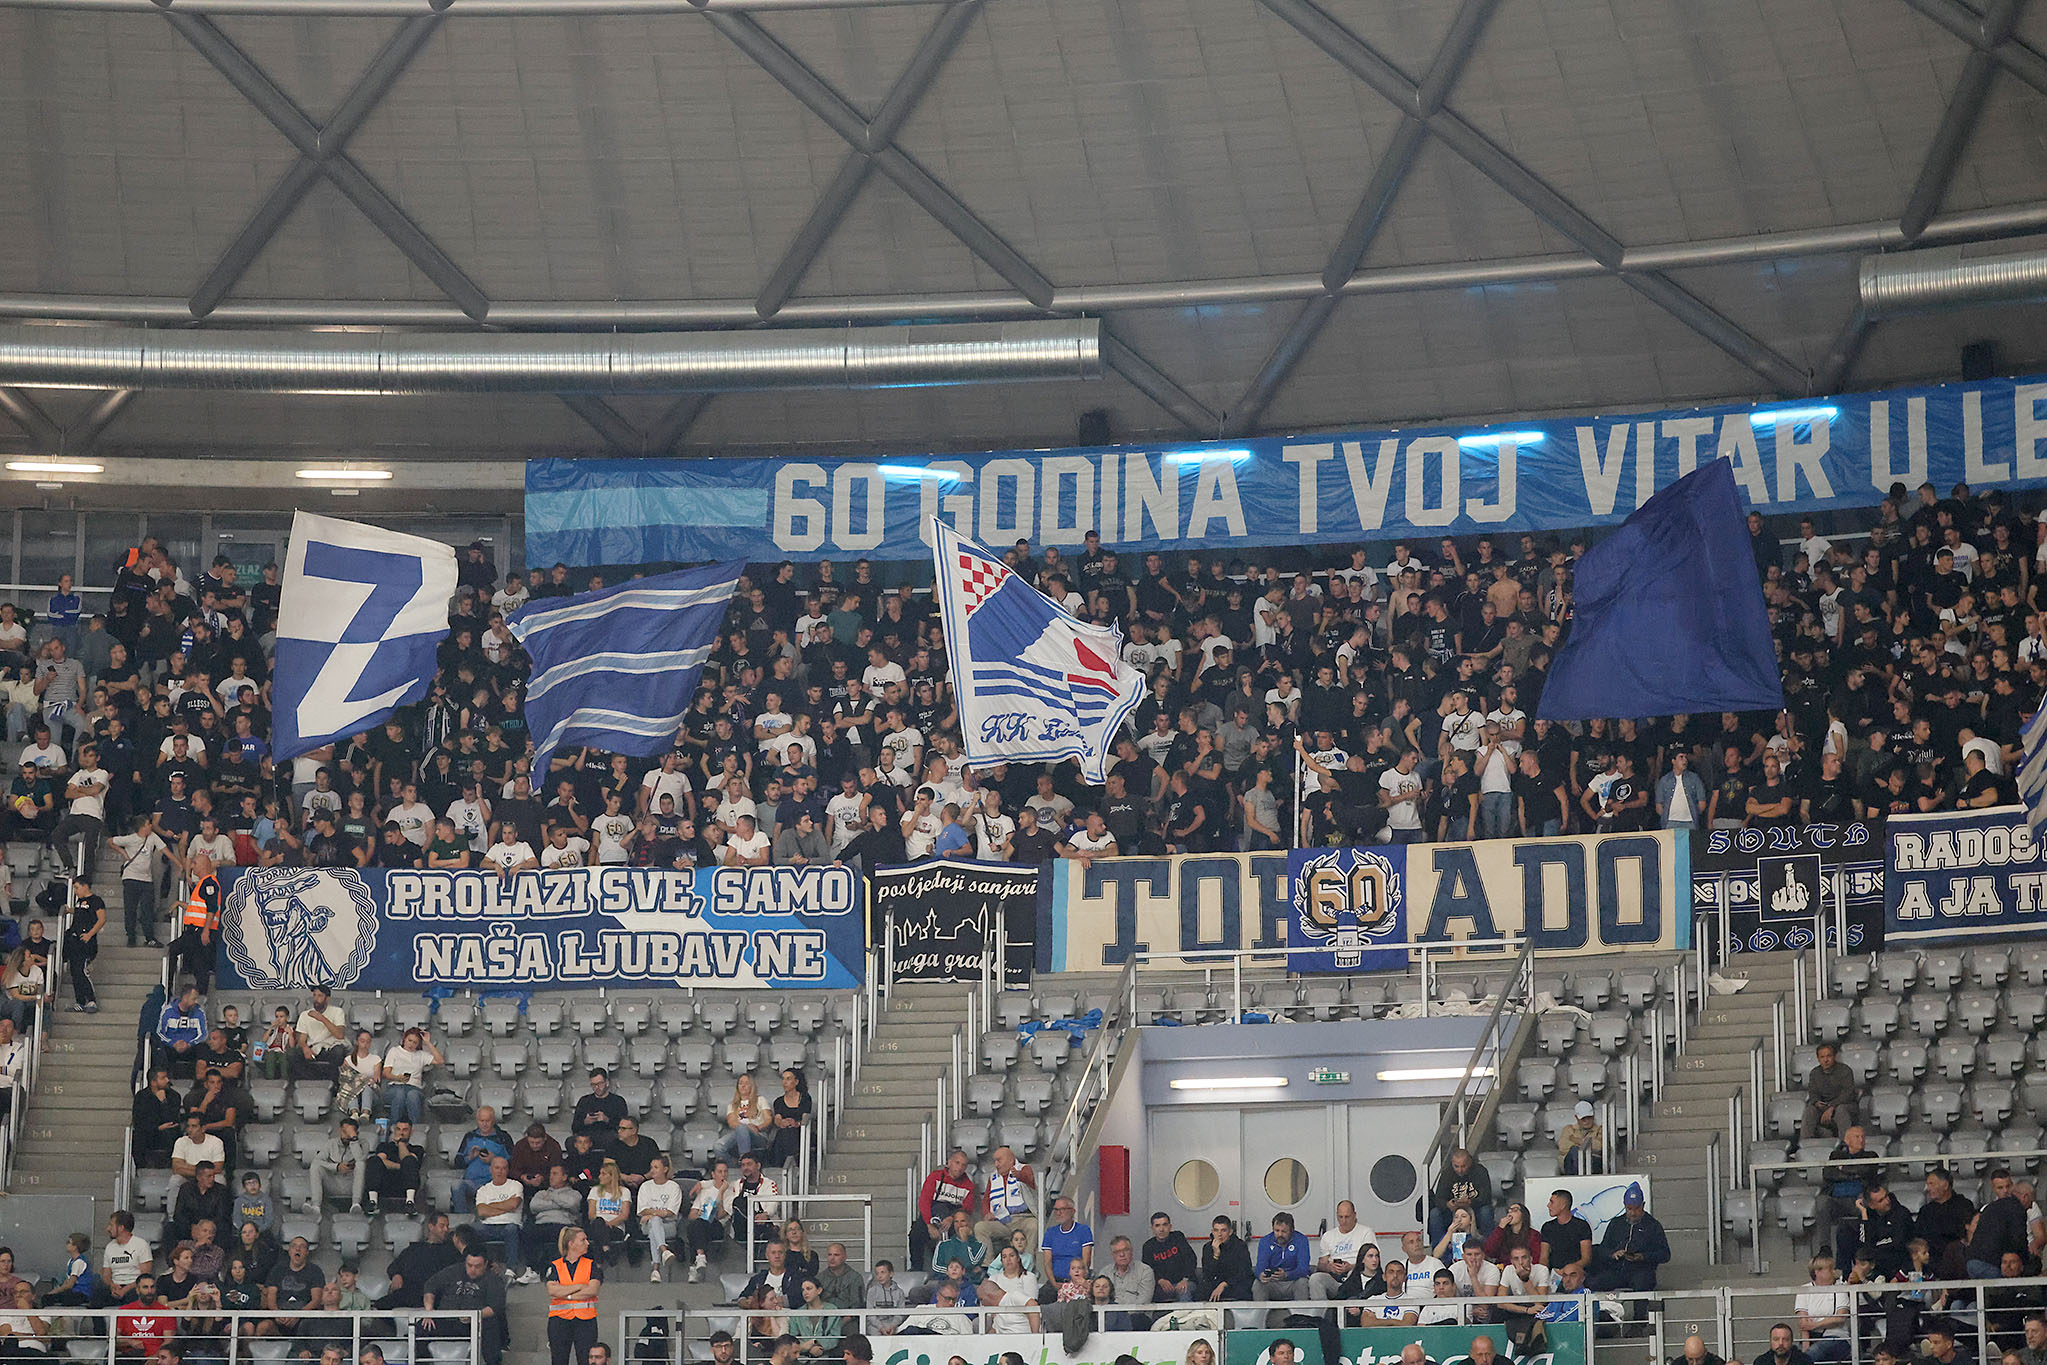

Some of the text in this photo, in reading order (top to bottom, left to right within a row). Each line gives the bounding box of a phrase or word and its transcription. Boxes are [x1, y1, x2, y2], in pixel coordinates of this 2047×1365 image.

[772, 462, 886, 552] 60
[919, 449, 1249, 549] GODINA
[1282, 431, 1518, 534] TVOJ
[1575, 408, 1836, 516] VITAR
[1870, 397, 1929, 495] U
[233, 564, 261, 576] ZLAZ
[1707, 822, 1870, 855] SOUTH
[1894, 823, 2047, 872] RADOS
[877, 870, 1039, 904] posljednji sanjari
[387, 868, 856, 918] PROLAZI SVE, SAMO
[1307, 864, 1390, 929] 60
[1896, 880, 1935, 921] A
[1939, 876, 2004, 918] JA
[415, 922, 827, 980] NAŠA LJUBAV NE
[1716, 1014, 1727, 1023] 16
[887, 1042, 898, 1051] 16
[1694, 1060, 1705, 1069] 15
[872, 1085, 882, 1094] 15
[1671, 1106, 1682, 1115] 14
[855, 1129, 866, 1138] 14
[837, 1175, 847, 1184] 13
[819, 1223, 830, 1232] 12
[111, 1256, 131, 1265] PUMA
[1407, 1270, 1431, 1281] ADAR
